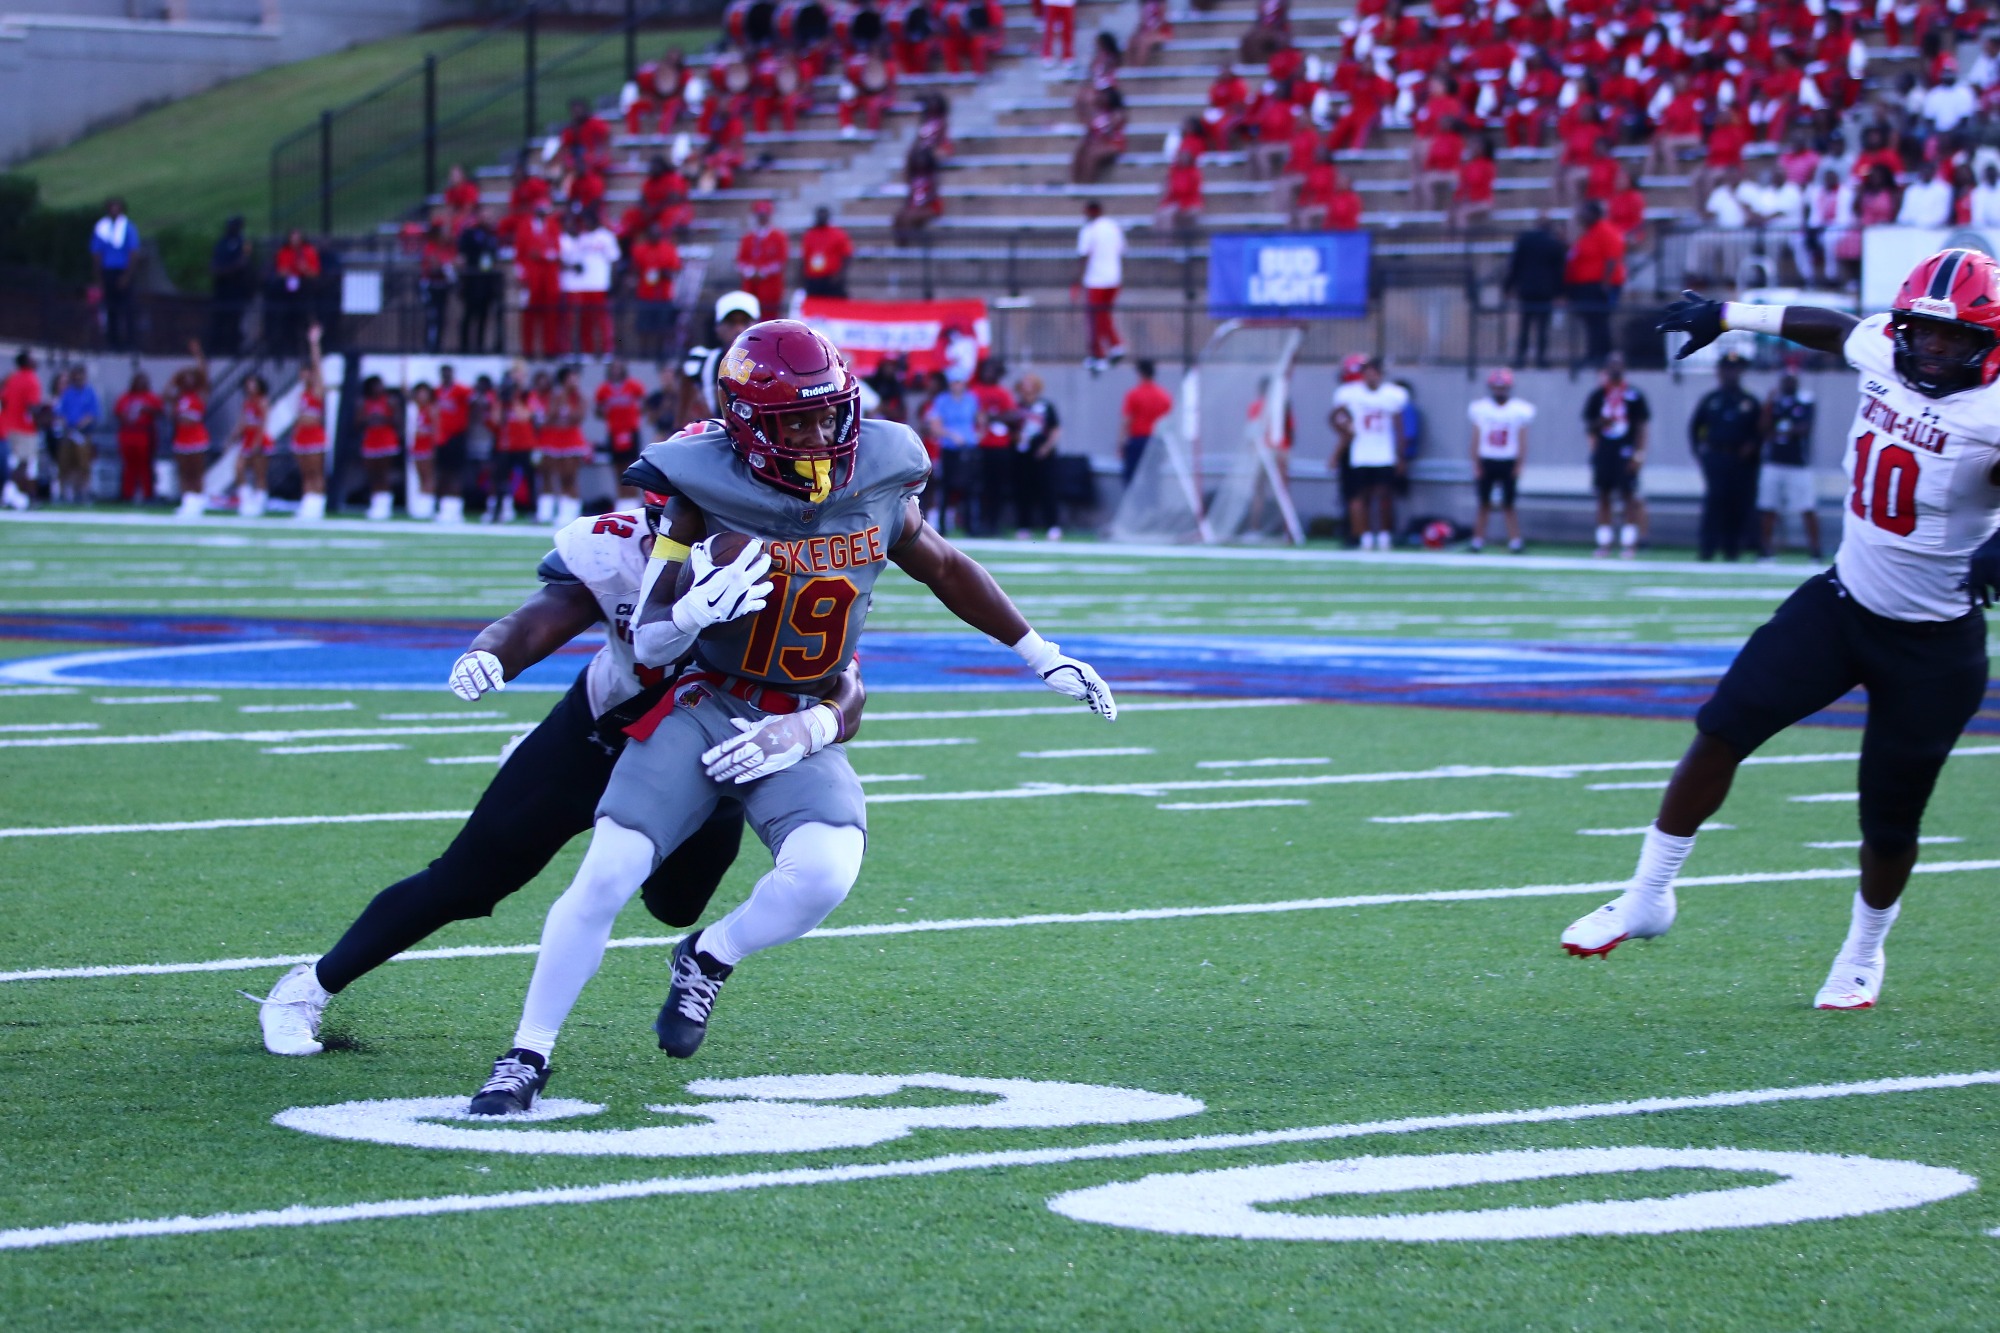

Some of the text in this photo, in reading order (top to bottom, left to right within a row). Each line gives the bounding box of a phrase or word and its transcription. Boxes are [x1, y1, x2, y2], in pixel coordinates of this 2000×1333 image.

[1259, 247, 1320, 276] BUD
[1248, 273, 1329, 305] LIGHT
[801, 383, 835, 398] Riddell
[1850, 430, 1920, 537] 10
[761, 525, 886, 574] SKEGEE
[741, 571, 860, 681] 19
